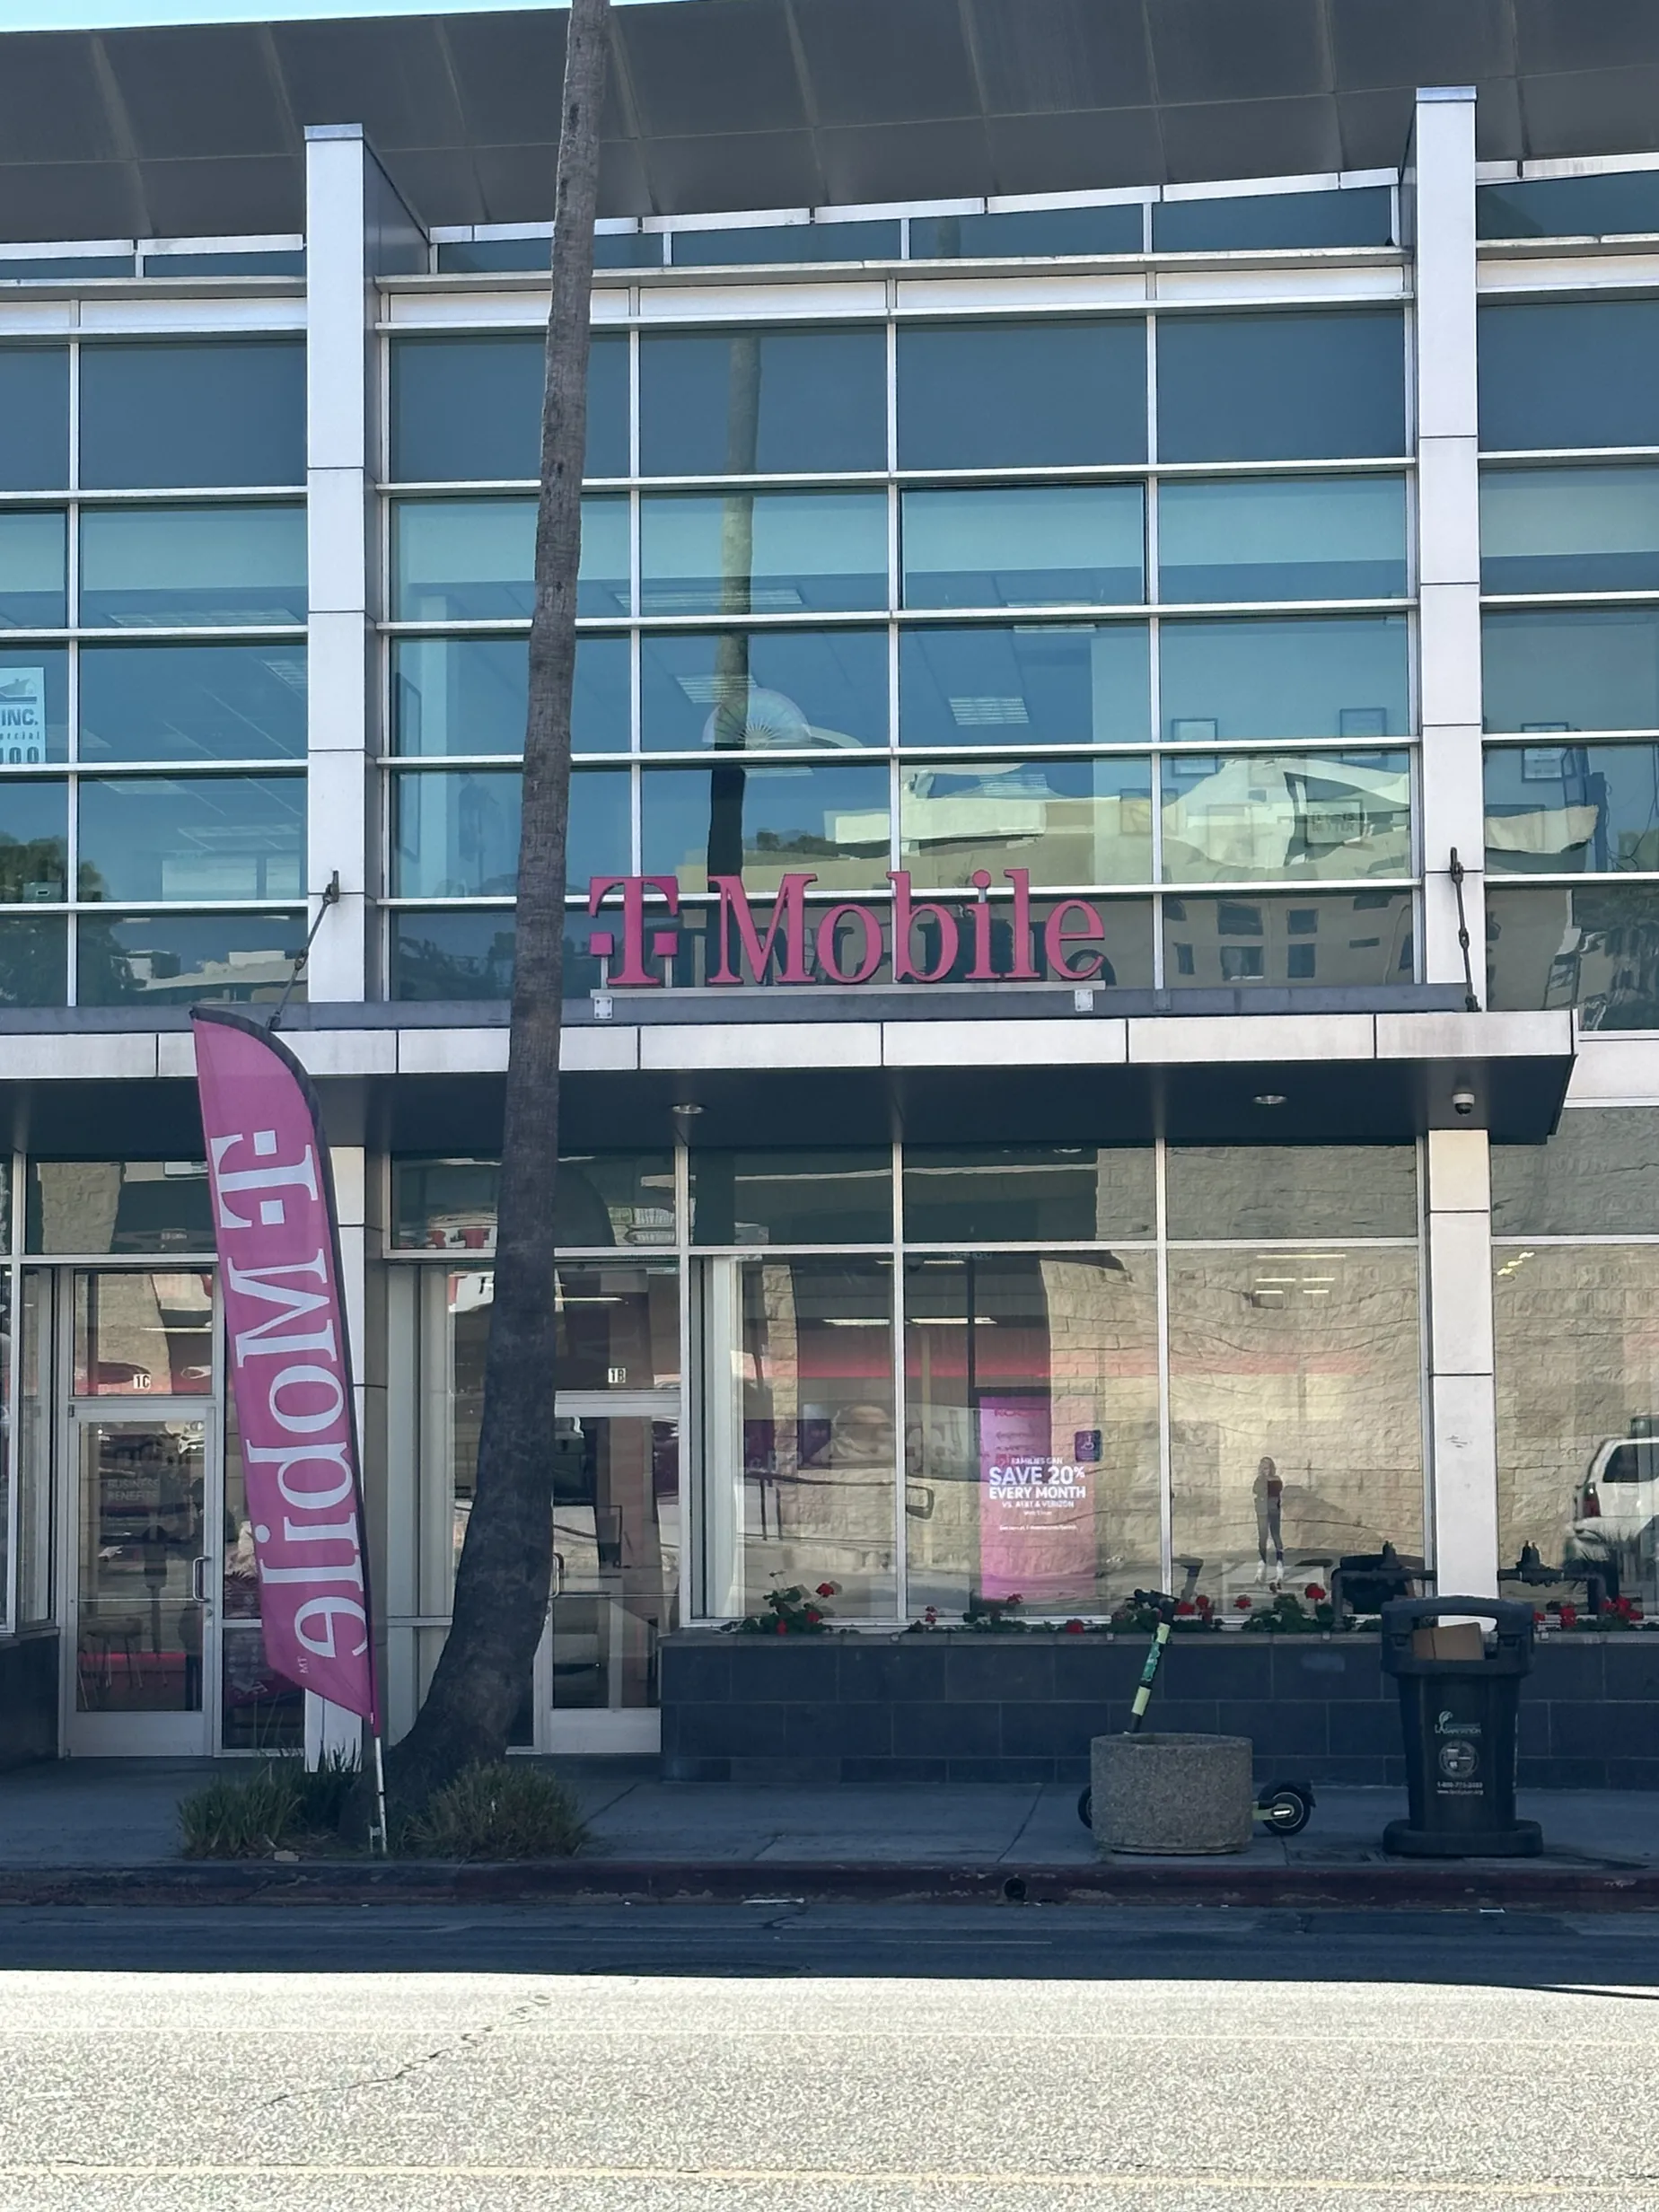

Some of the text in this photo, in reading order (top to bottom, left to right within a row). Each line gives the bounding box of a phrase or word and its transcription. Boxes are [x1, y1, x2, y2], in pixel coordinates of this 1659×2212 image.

[2, 708, 39, 726] INC.
[136, 1374, 151, 1388] 1C
[611, 1369, 625, 1382] 1B
[988, 1465, 1085, 1485] SAVE 20%
[989, 1486, 1086, 1499] EVERY MONTH
